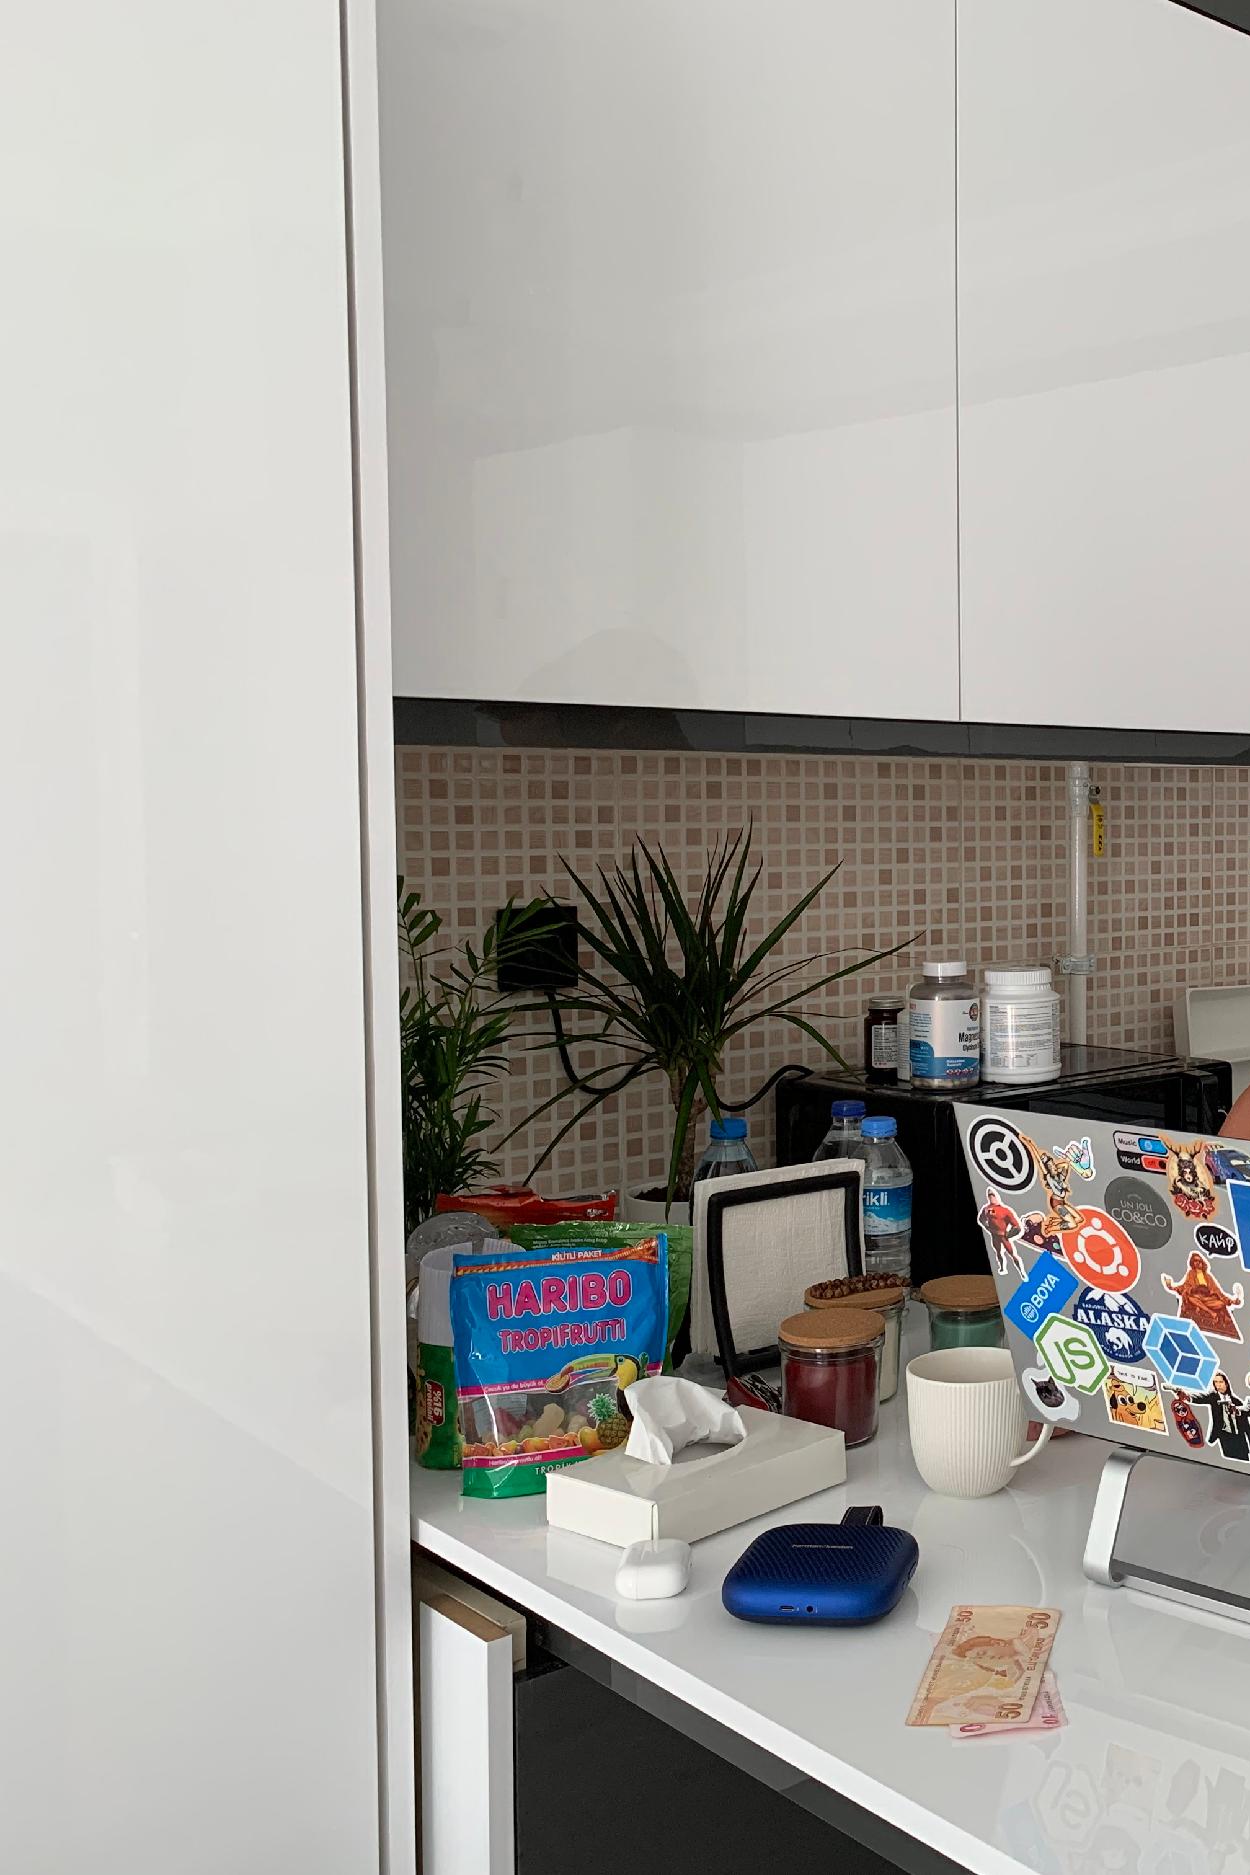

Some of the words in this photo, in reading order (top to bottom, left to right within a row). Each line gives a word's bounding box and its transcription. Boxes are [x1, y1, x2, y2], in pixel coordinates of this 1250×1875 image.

[577, 1249, 602, 1260] PAKET
[486, 1269, 633, 1320] HARIBO
[1030, 1273, 1060, 1309] BOYA
[1077, 1309, 1150, 1332] ALASKA
[498, 1317, 627, 1355] TROPIFRUTTI
[955, 1610, 974, 1623] 50
[1026, 1612, 1051, 1630] 50
[995, 1702, 1024, 1719] 50
